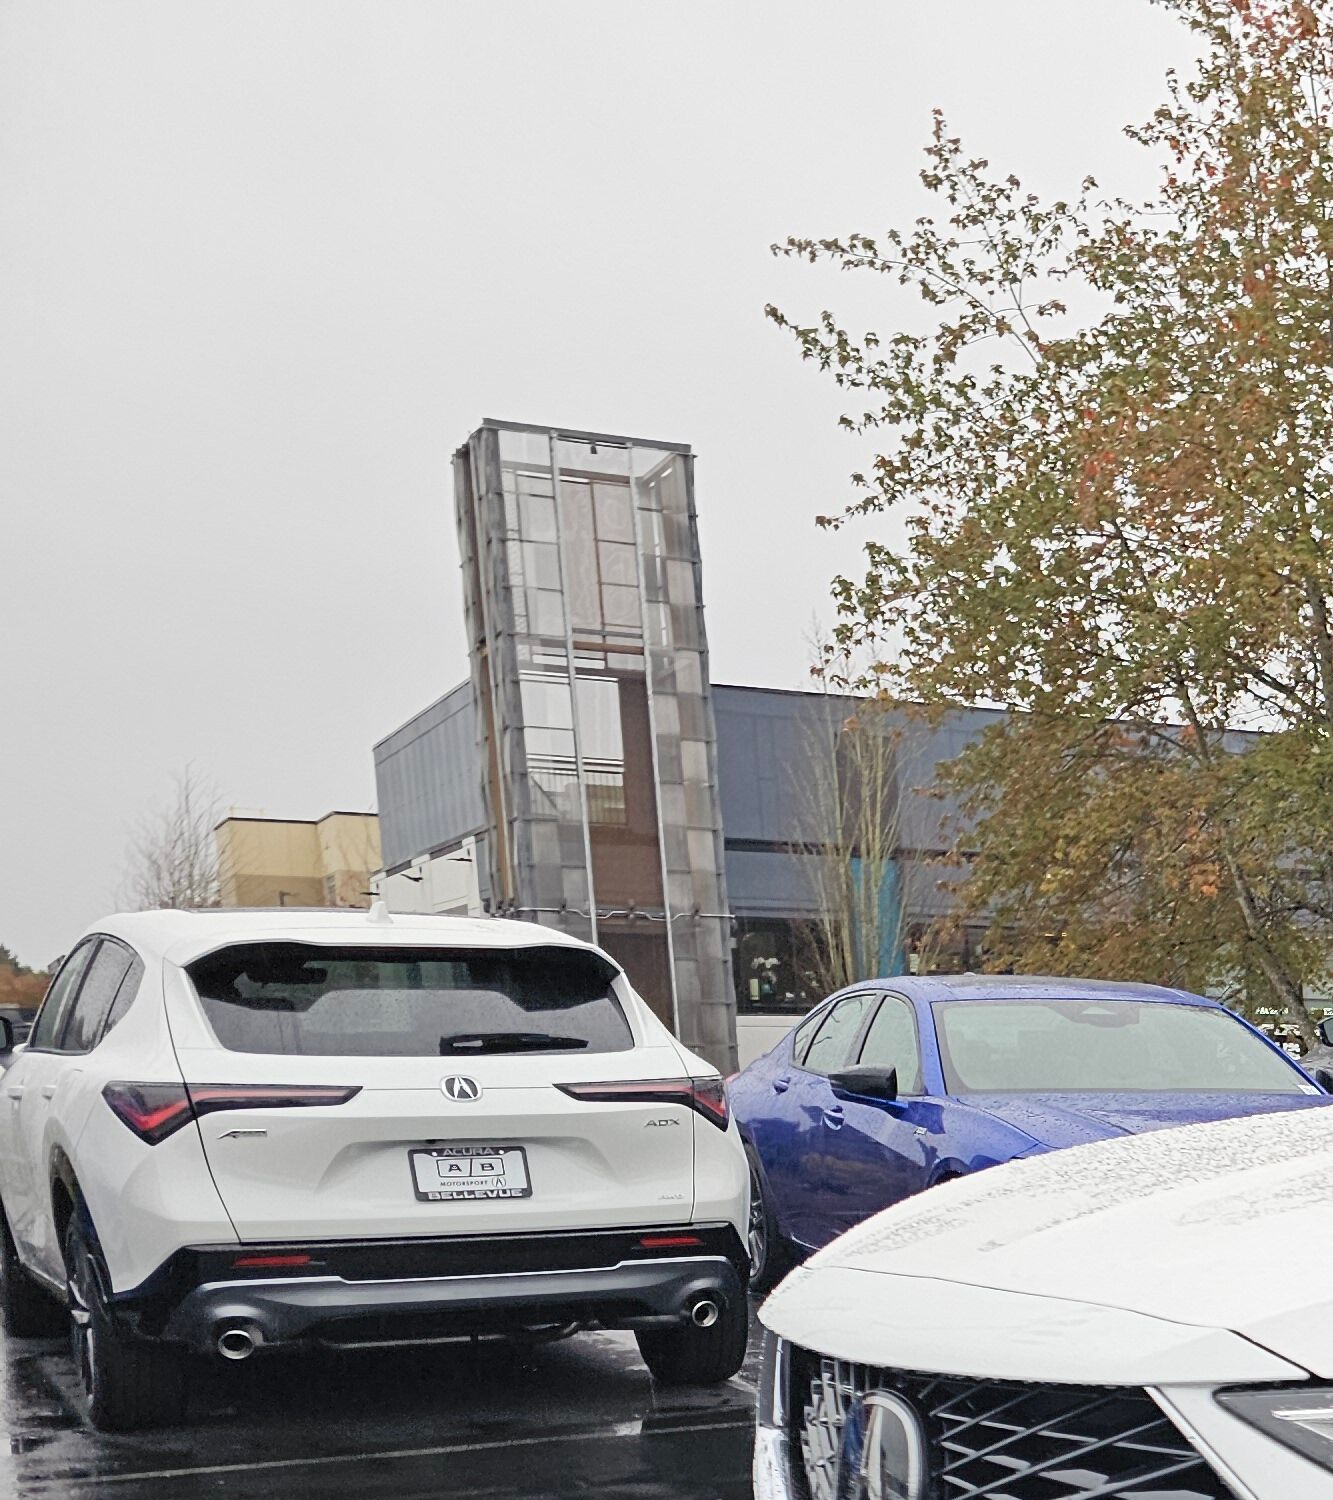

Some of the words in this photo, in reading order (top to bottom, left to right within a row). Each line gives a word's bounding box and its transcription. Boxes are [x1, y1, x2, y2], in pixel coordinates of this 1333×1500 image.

[643, 1118, 680, 1128] ADX
[443, 1147, 495, 1156] ACURA
[448, 1164, 462, 1172] A
[481, 1163, 495, 1171] B
[427, 1189, 523, 1200] BELLEVUE
